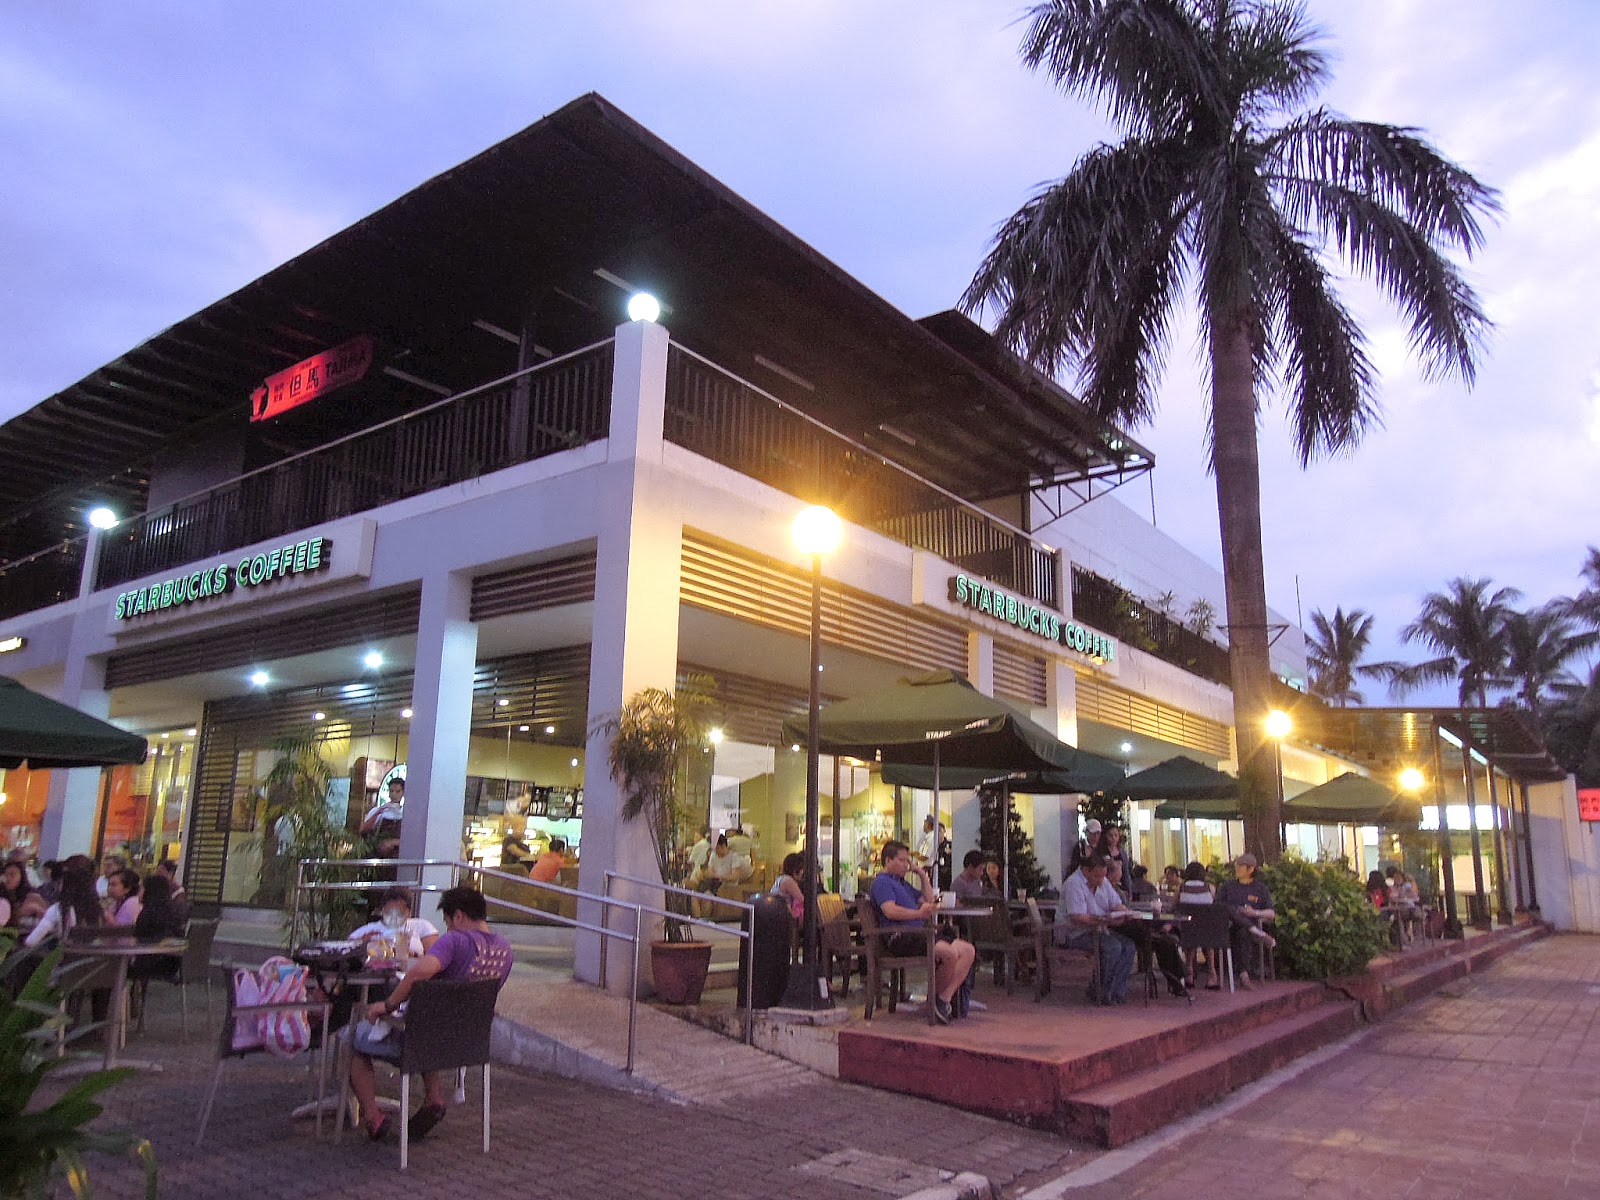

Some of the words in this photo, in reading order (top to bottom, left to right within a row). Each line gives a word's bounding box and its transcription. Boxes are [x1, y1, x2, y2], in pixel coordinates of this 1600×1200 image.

[115, 563, 229, 619] STARBUCKS
[235, 536, 323, 588] COFFEE
[956, 573, 1060, 642] STARBUCKS
[1065, 621, 1114, 662] COFFEE
